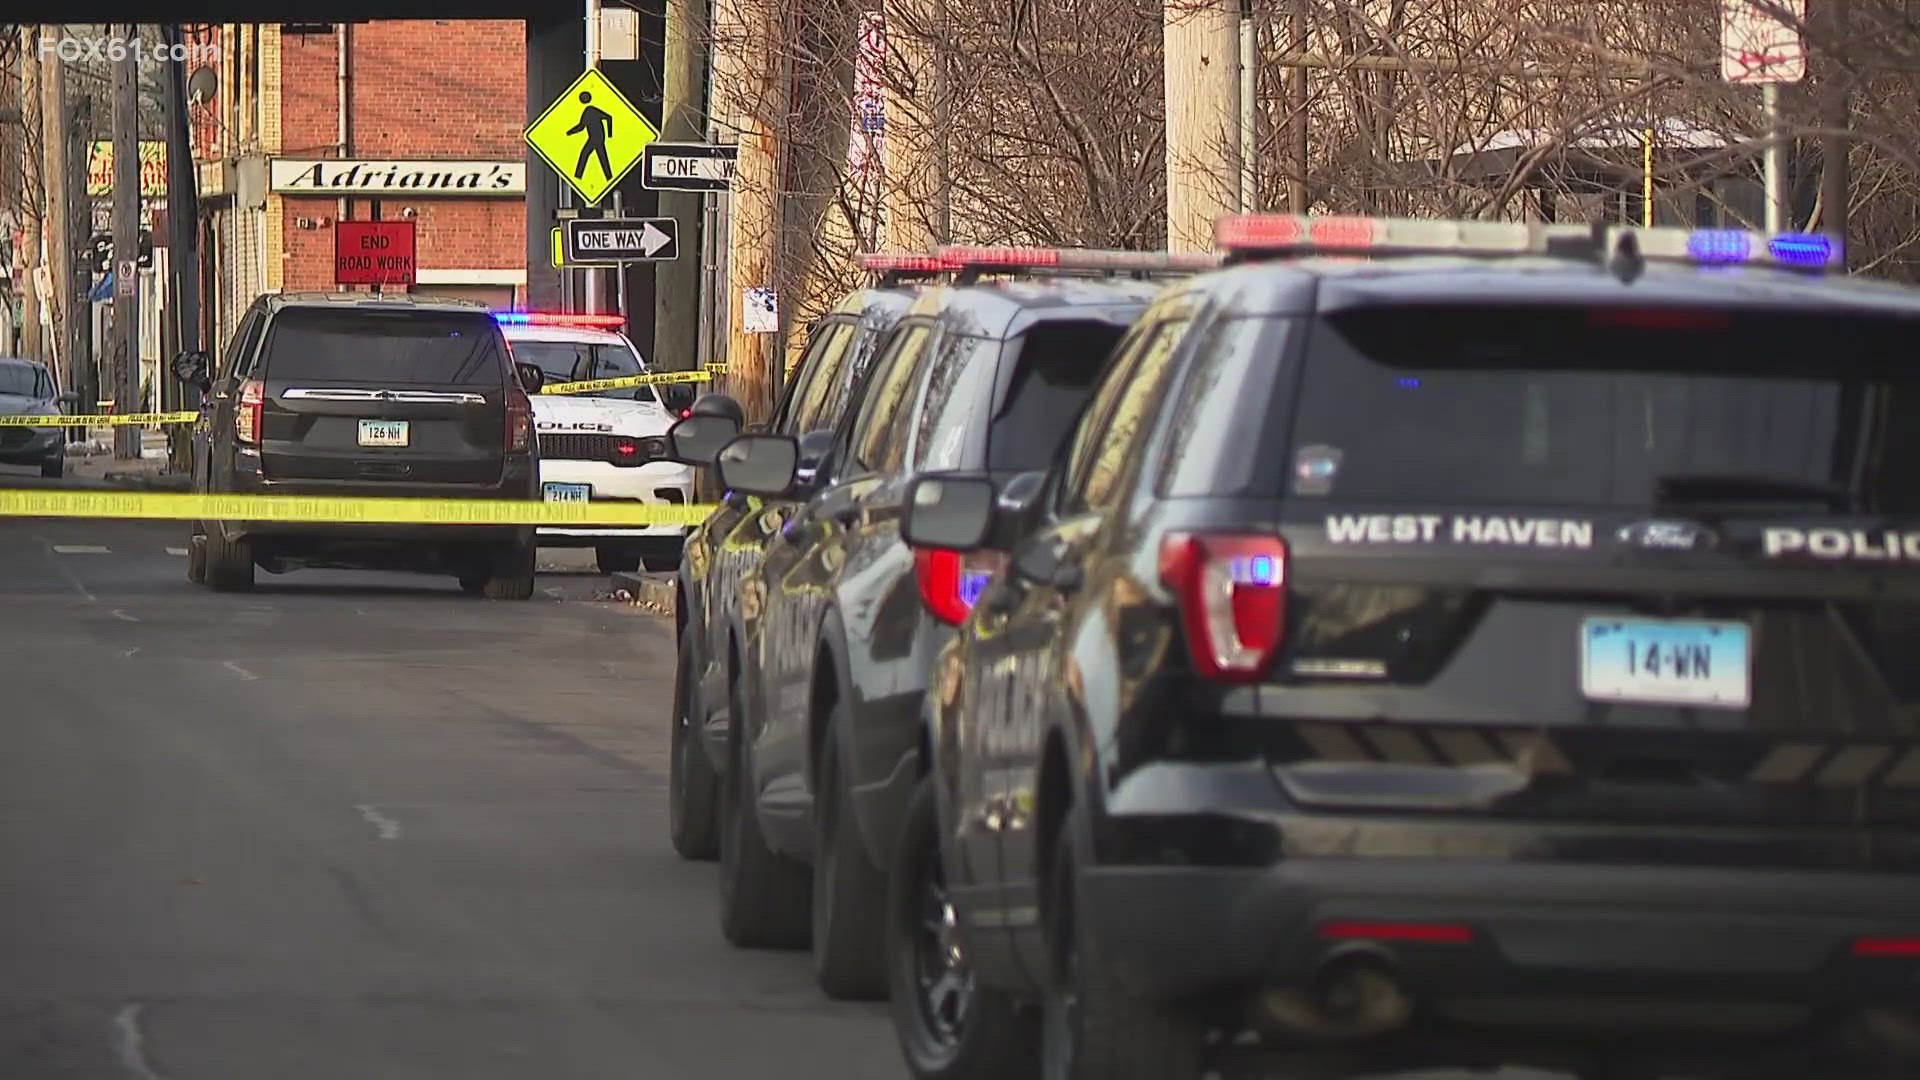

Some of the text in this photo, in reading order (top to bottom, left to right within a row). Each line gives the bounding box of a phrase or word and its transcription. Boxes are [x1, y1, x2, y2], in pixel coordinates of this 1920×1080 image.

[287, 162, 512, 188] Adriana's
[667, 159, 737, 178] ONE W
[361, 235, 390, 249] END
[582, 232, 644, 248] ONE WAY
[340, 256, 411, 270] ROAD WORK
[537, 421, 613, 432] OLICE
[1326, 514, 1594, 547] WEST HAVEN
